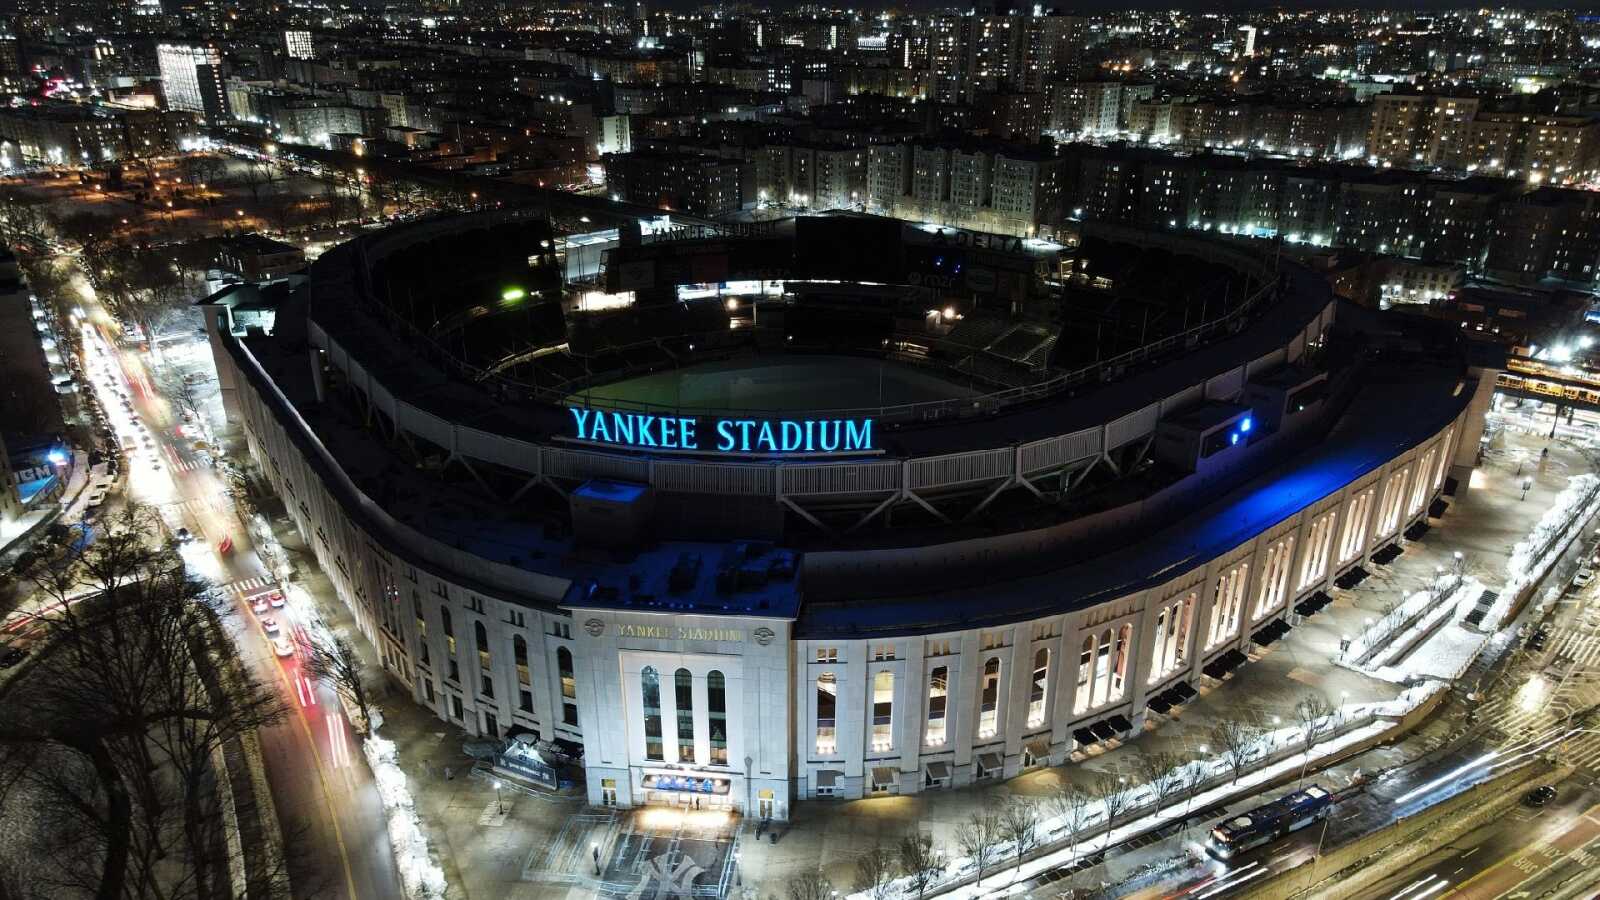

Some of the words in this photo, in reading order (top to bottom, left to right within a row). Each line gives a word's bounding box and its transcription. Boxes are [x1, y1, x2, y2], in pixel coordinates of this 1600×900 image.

[955, 231, 1022, 253] DELTA
[569, 407, 698, 449] YANKEE
[716, 419, 873, 451] STADIUM
[1513, 856, 1538, 873] BUS
